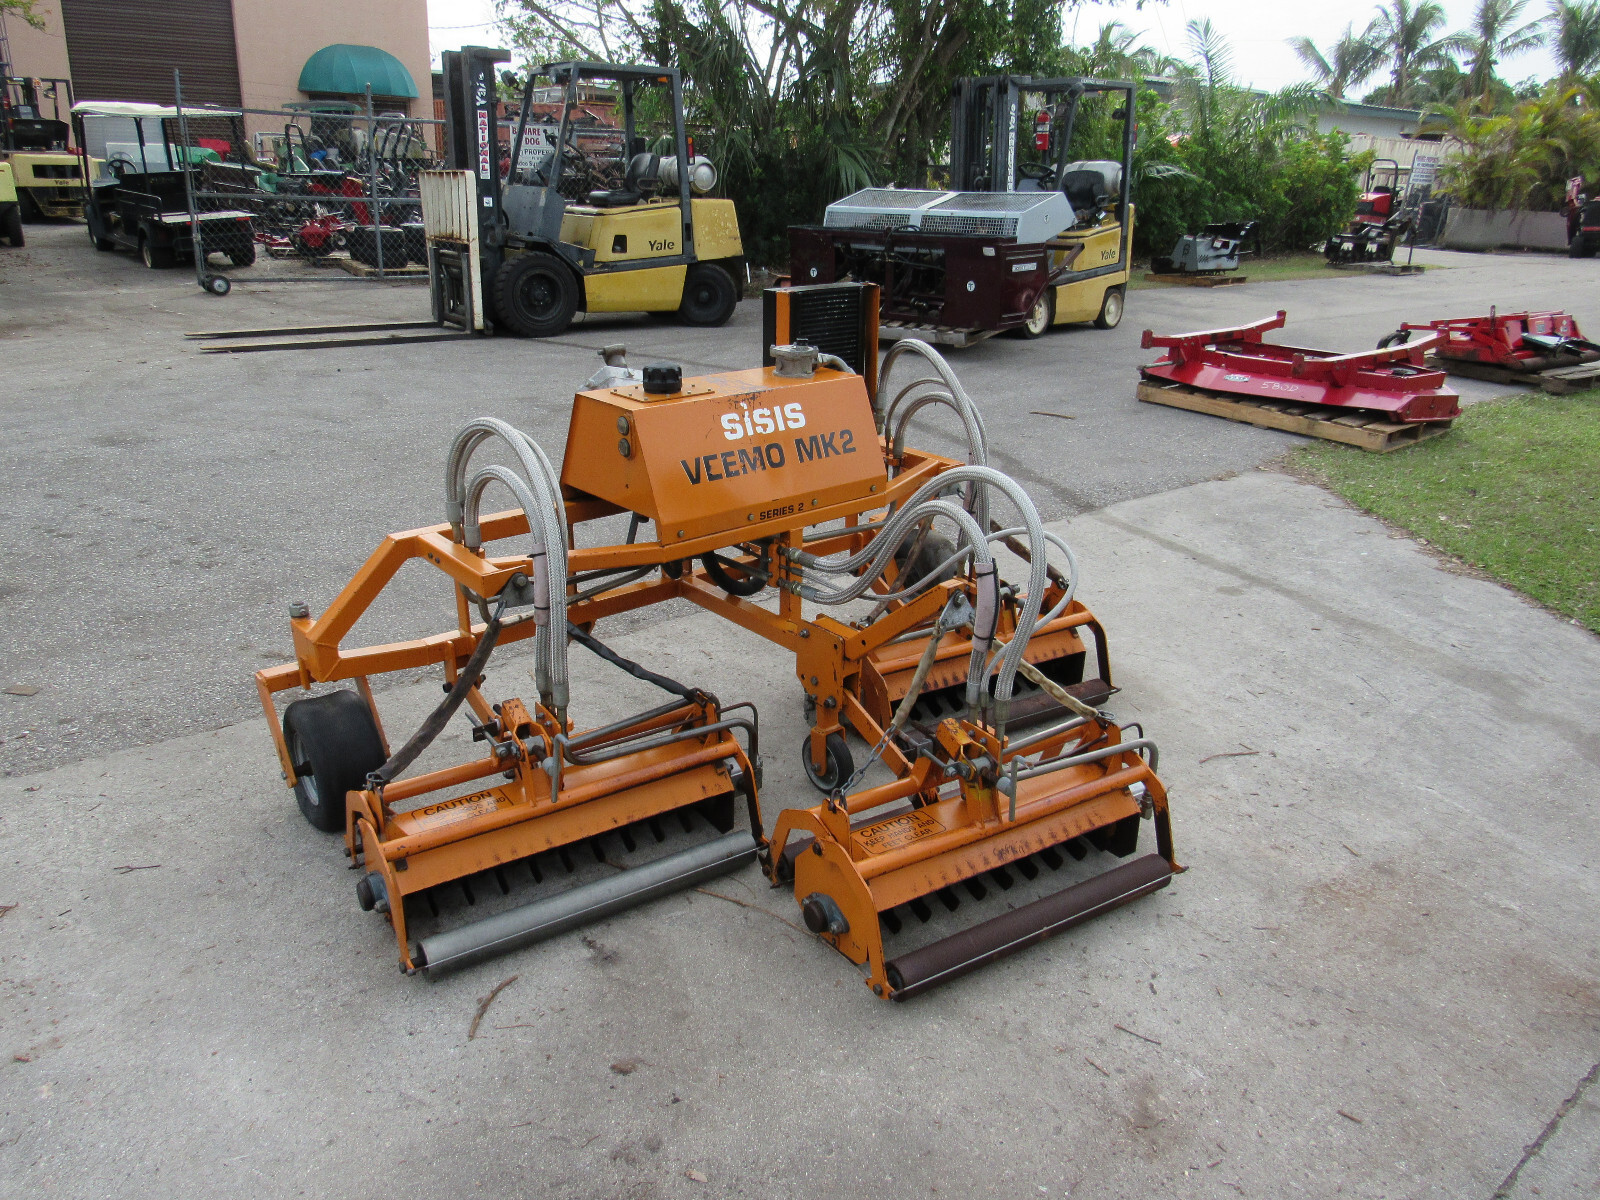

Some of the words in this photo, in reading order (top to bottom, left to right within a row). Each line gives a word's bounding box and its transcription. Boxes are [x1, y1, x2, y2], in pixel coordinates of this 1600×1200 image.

[479, 112, 489, 171] NATIONAL
[648, 239, 675, 252] Yale
[1101, 249, 1116, 261] Yale
[680, 442, 786, 485] VEEMO
[794, 429, 857, 464] MK2
[759, 504, 794, 520] SERIES
[797, 502, 805, 512] 2
[423, 791, 493, 816] CAUTION
[860, 813, 920, 838] CAUTION
[863, 836, 885, 847] KEEP
[888, 825, 916, 839] HANDS
[917, 819, 935, 829] AND
[882, 838, 903, 849] FEET
[904, 828, 933, 841] CLEAR
